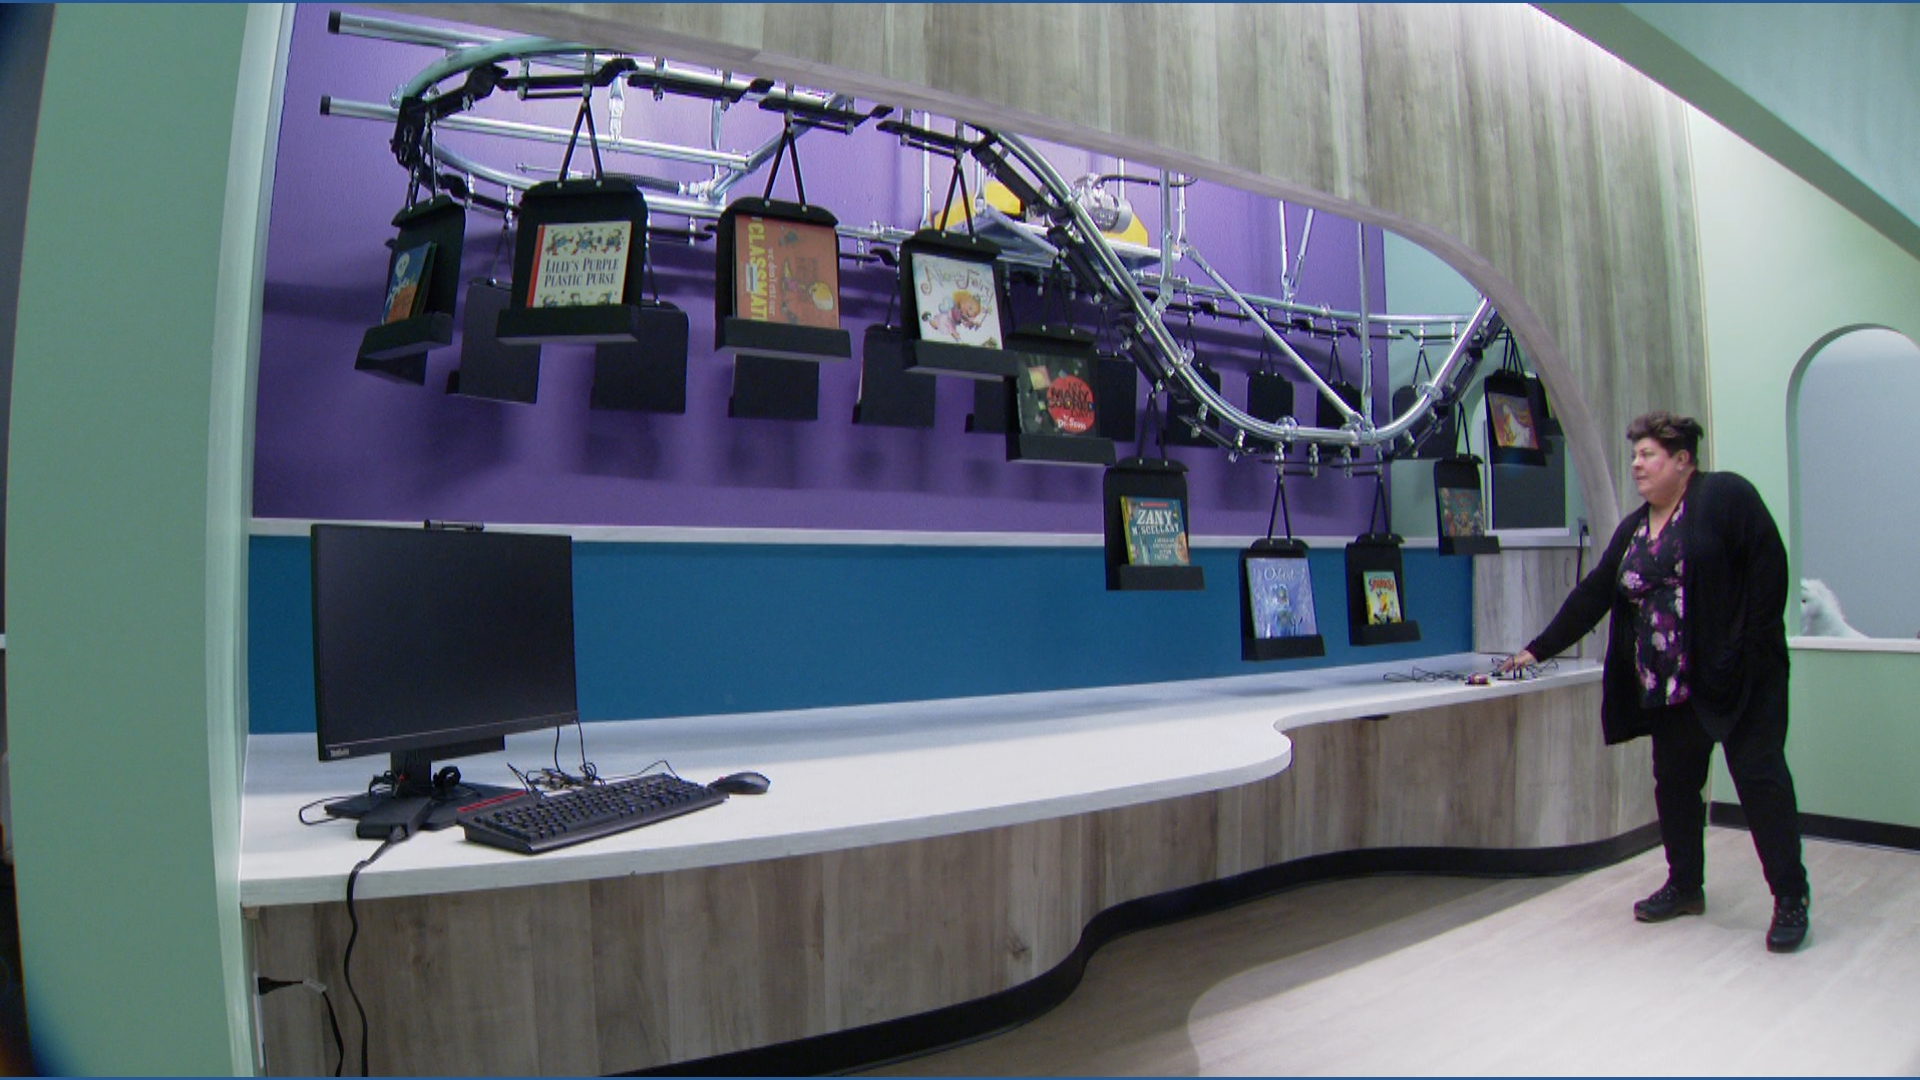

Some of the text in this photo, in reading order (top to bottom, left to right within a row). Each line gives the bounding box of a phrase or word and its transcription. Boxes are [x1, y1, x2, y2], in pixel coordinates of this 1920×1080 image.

[545, 256, 619, 273] LILLY'S PURPLE
[747, 222, 768, 321] CLASSMAT
[544, 271, 616, 288] PLASTIC PURSE
[1051, 387, 1089, 401] MANY
[1136, 509, 1172, 526] ZANY
